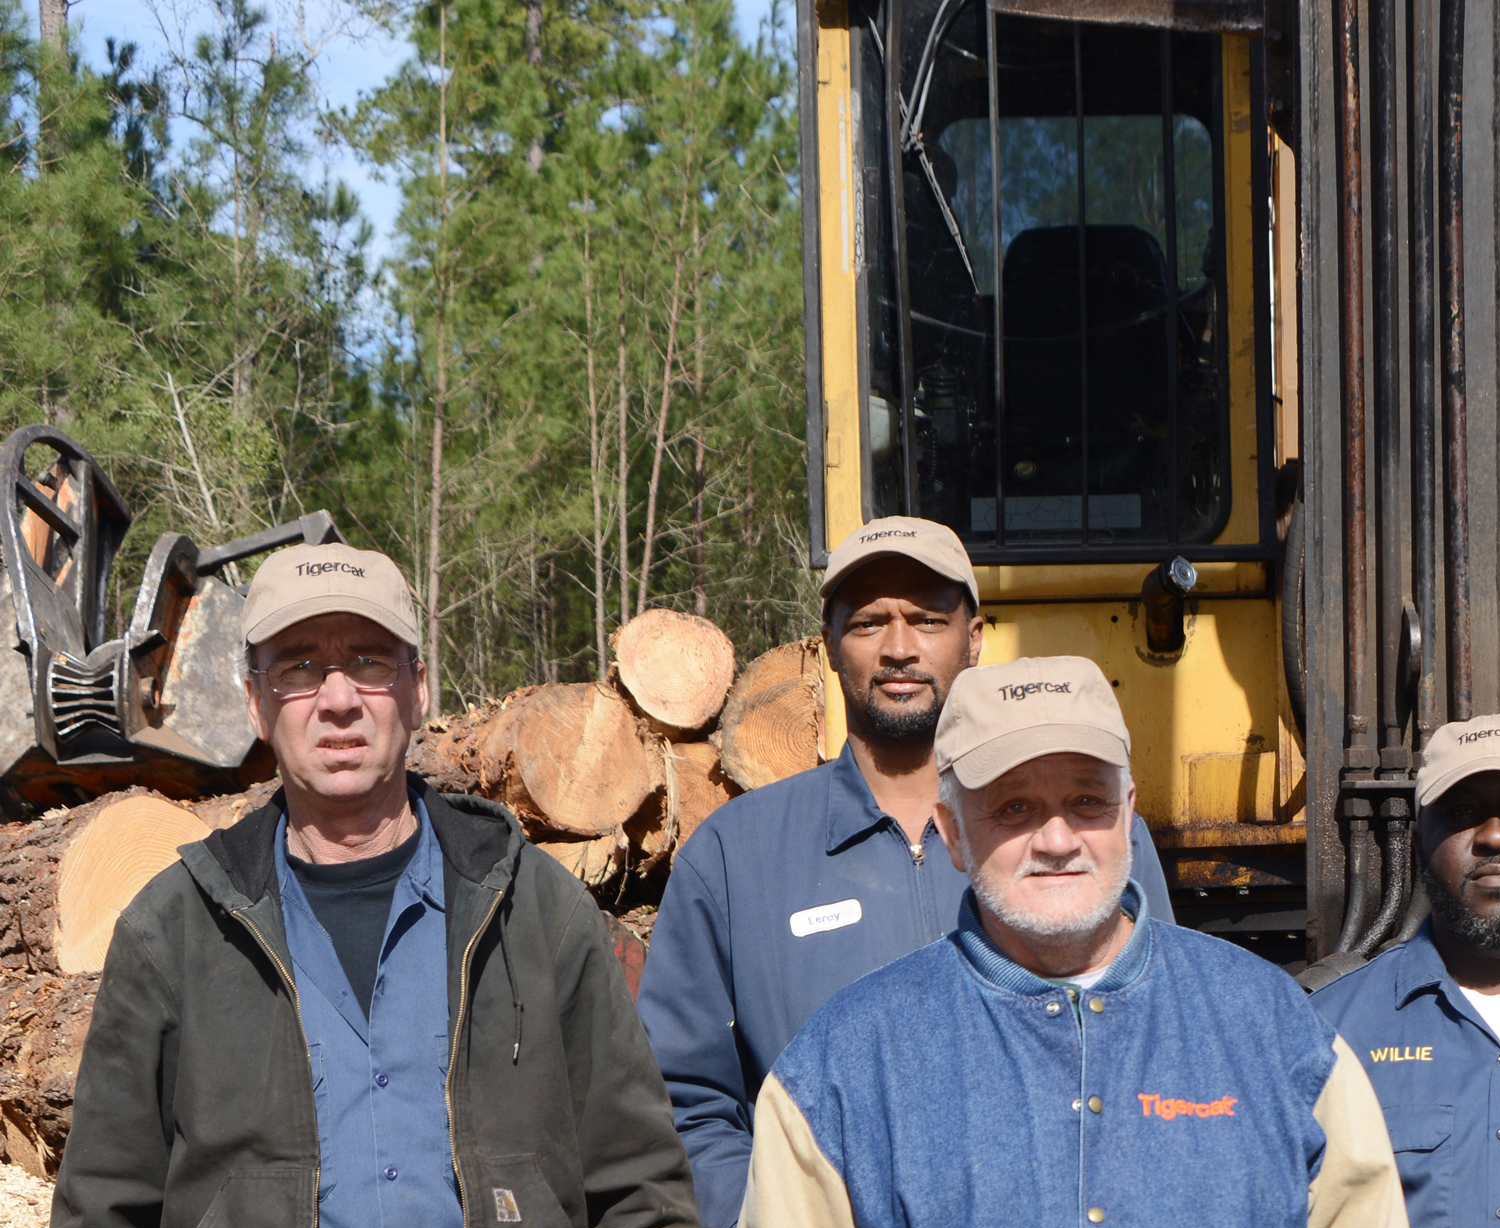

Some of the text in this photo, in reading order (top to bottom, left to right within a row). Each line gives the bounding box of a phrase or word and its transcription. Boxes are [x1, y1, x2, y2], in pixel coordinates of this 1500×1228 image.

[859, 529, 918, 544] Tigercat
[294, 561, 367, 579] Tigercat
[998, 681, 1072, 702] Tigercat
[807, 912, 841, 926] Leroy
[1369, 1046, 1434, 1063] WILLIE
[1137, 1093, 1238, 1121] Tigercat
